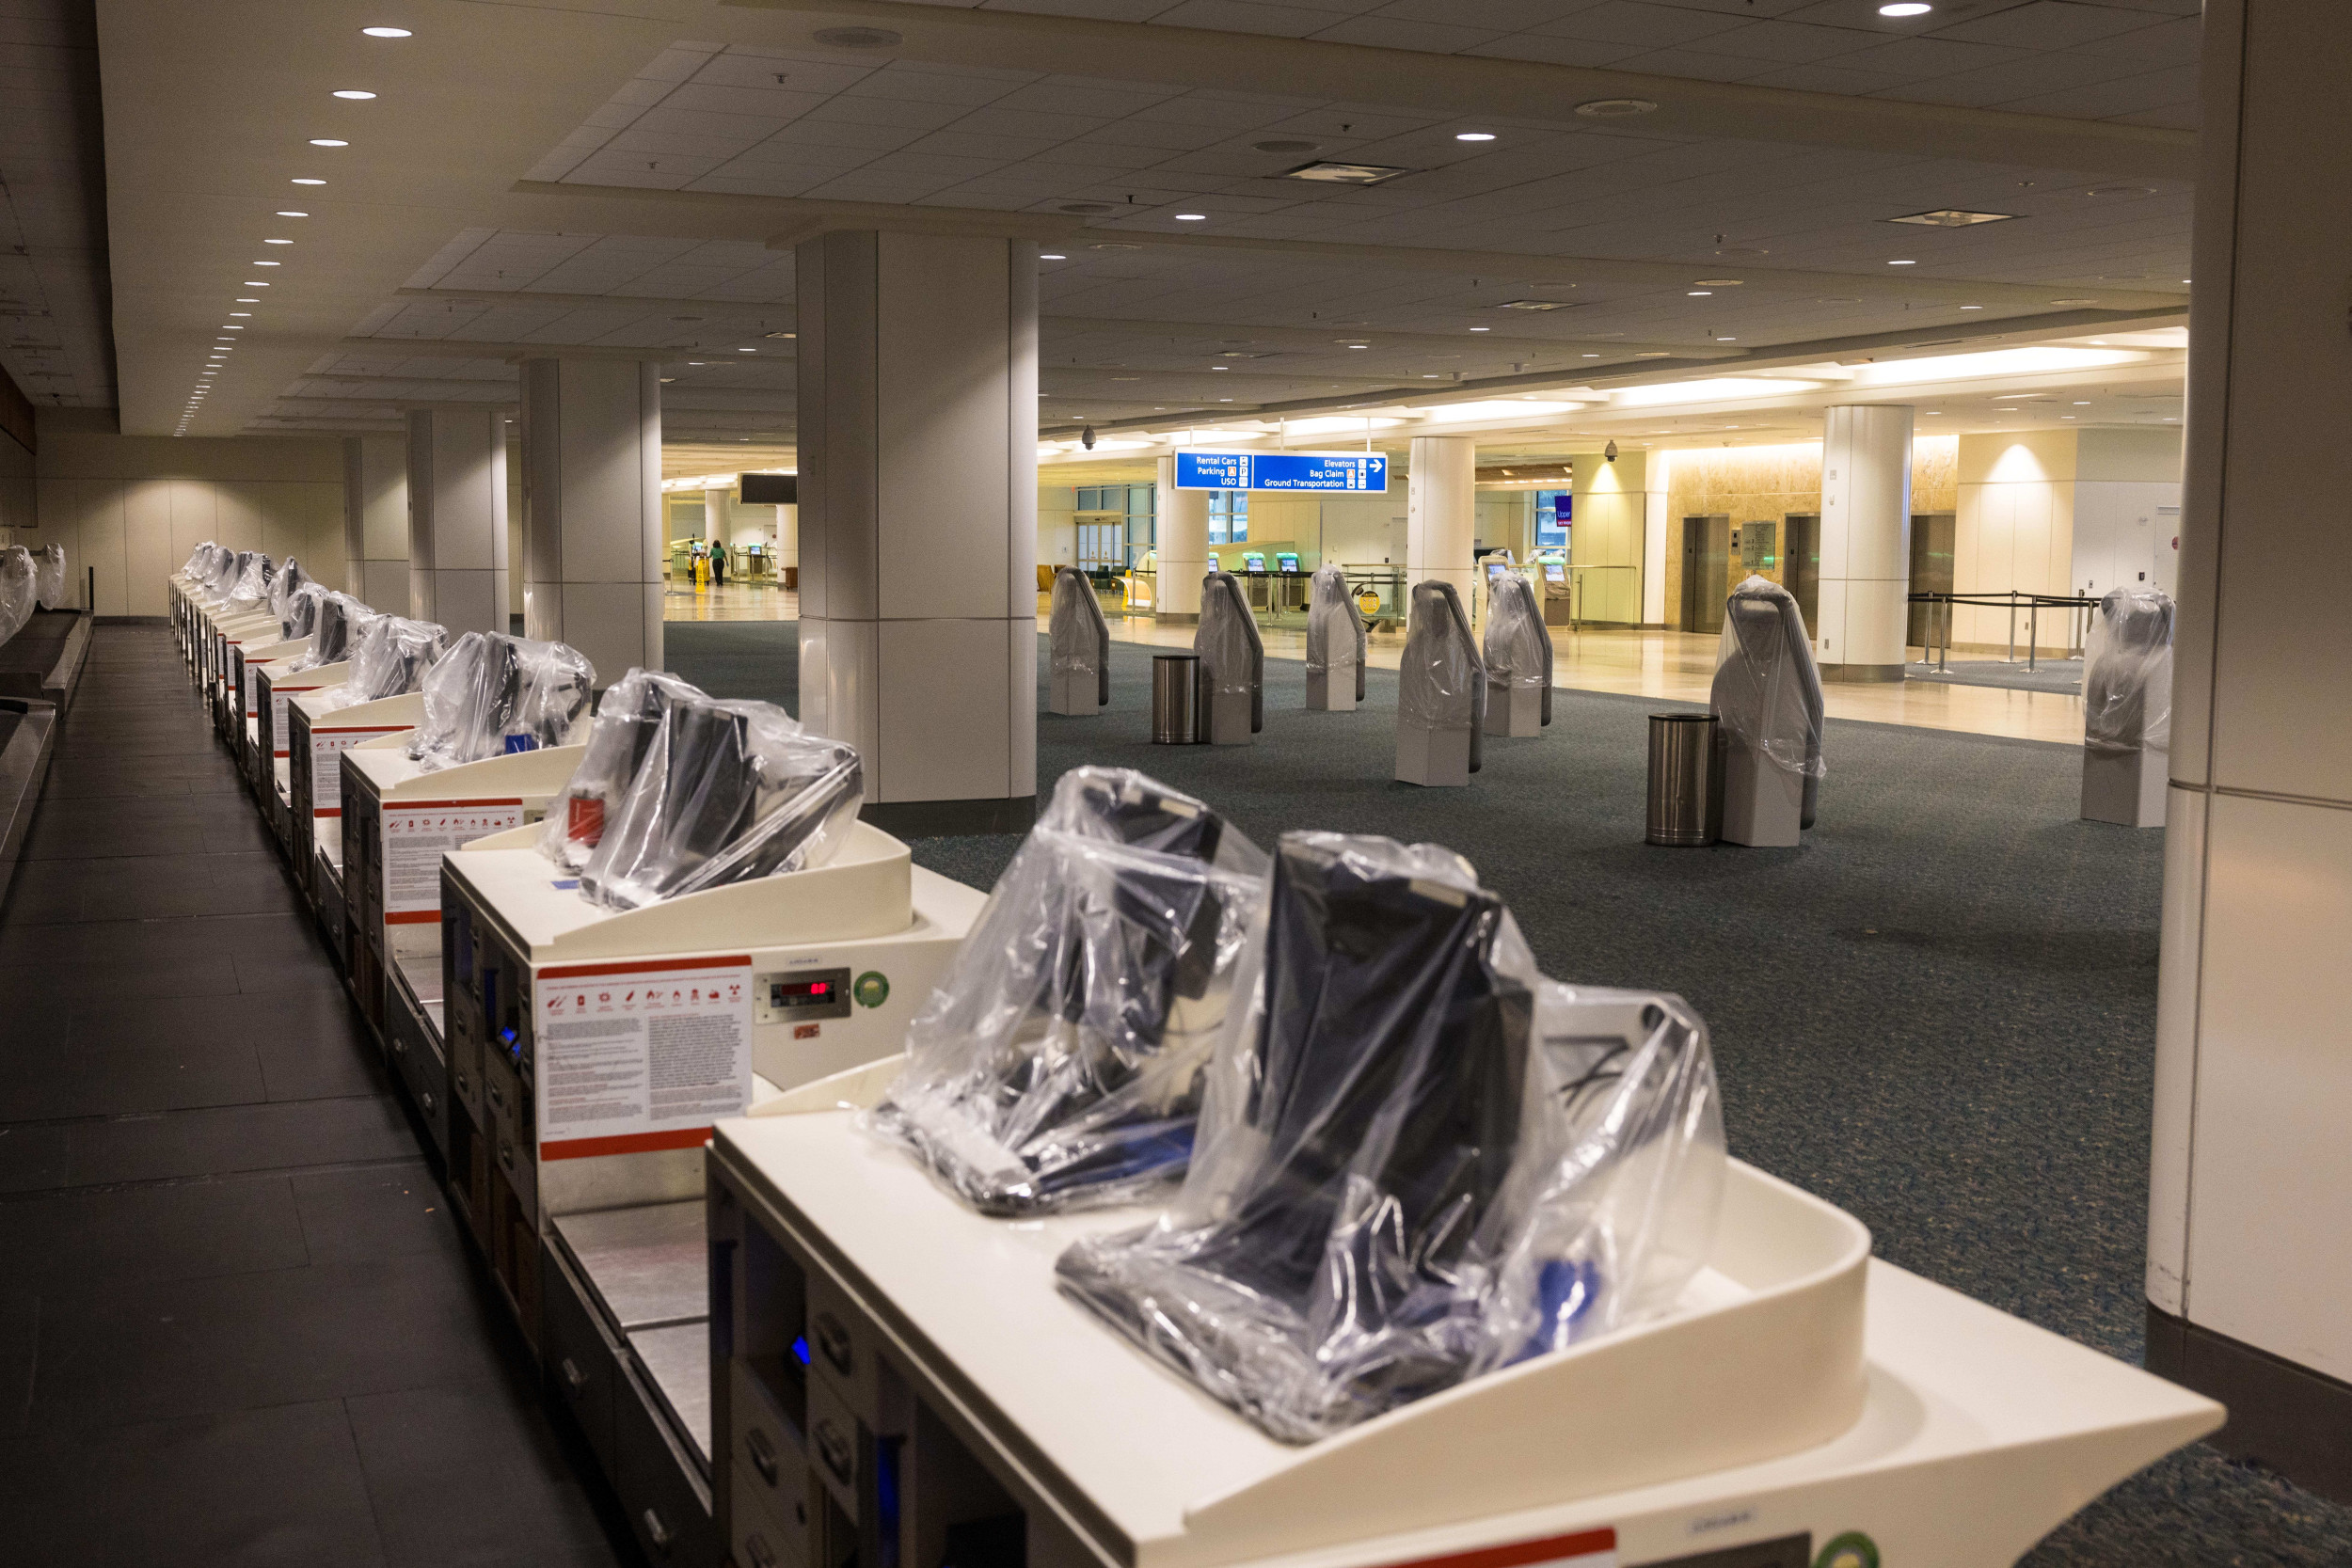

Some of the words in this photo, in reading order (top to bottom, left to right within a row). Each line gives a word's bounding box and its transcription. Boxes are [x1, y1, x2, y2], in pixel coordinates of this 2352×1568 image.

[1197, 456, 1220, 465] Rental
[1324, 459, 1356, 467] Elevators
[1198, 467, 1225, 477] Parking
[1310, 469, 1324, 479] Bag
[1264, 479, 1292, 487] Ground
[1293, 479, 1344, 488] Transportation
[1557, 511, 1571, 519] Upper
